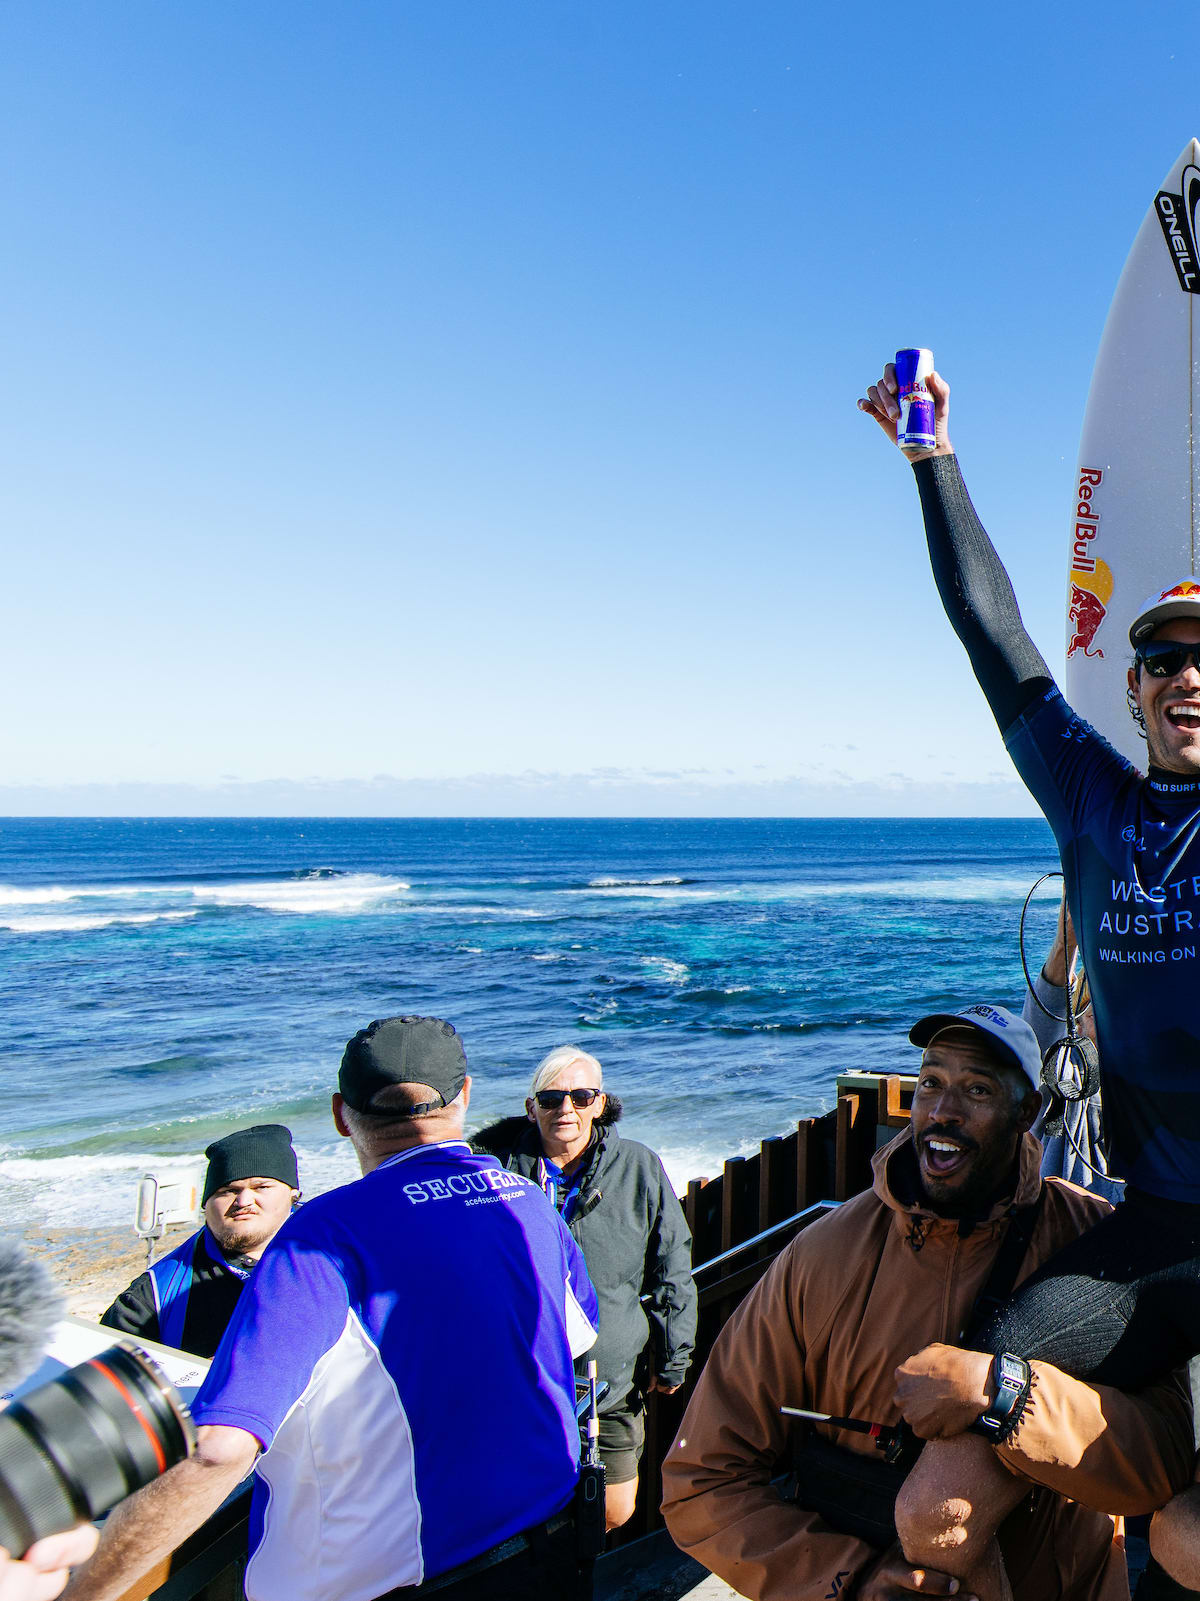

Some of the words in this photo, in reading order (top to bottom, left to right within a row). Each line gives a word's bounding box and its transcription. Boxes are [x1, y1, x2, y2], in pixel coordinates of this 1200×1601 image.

[1159, 196, 1196, 289] O'NEILL
[1170, 784, 1196, 792] SURF
[1100, 948, 1166, 963] WALKING
[1171, 946, 1196, 961] ON
[464, 1190, 526, 1207] ace4security.com
